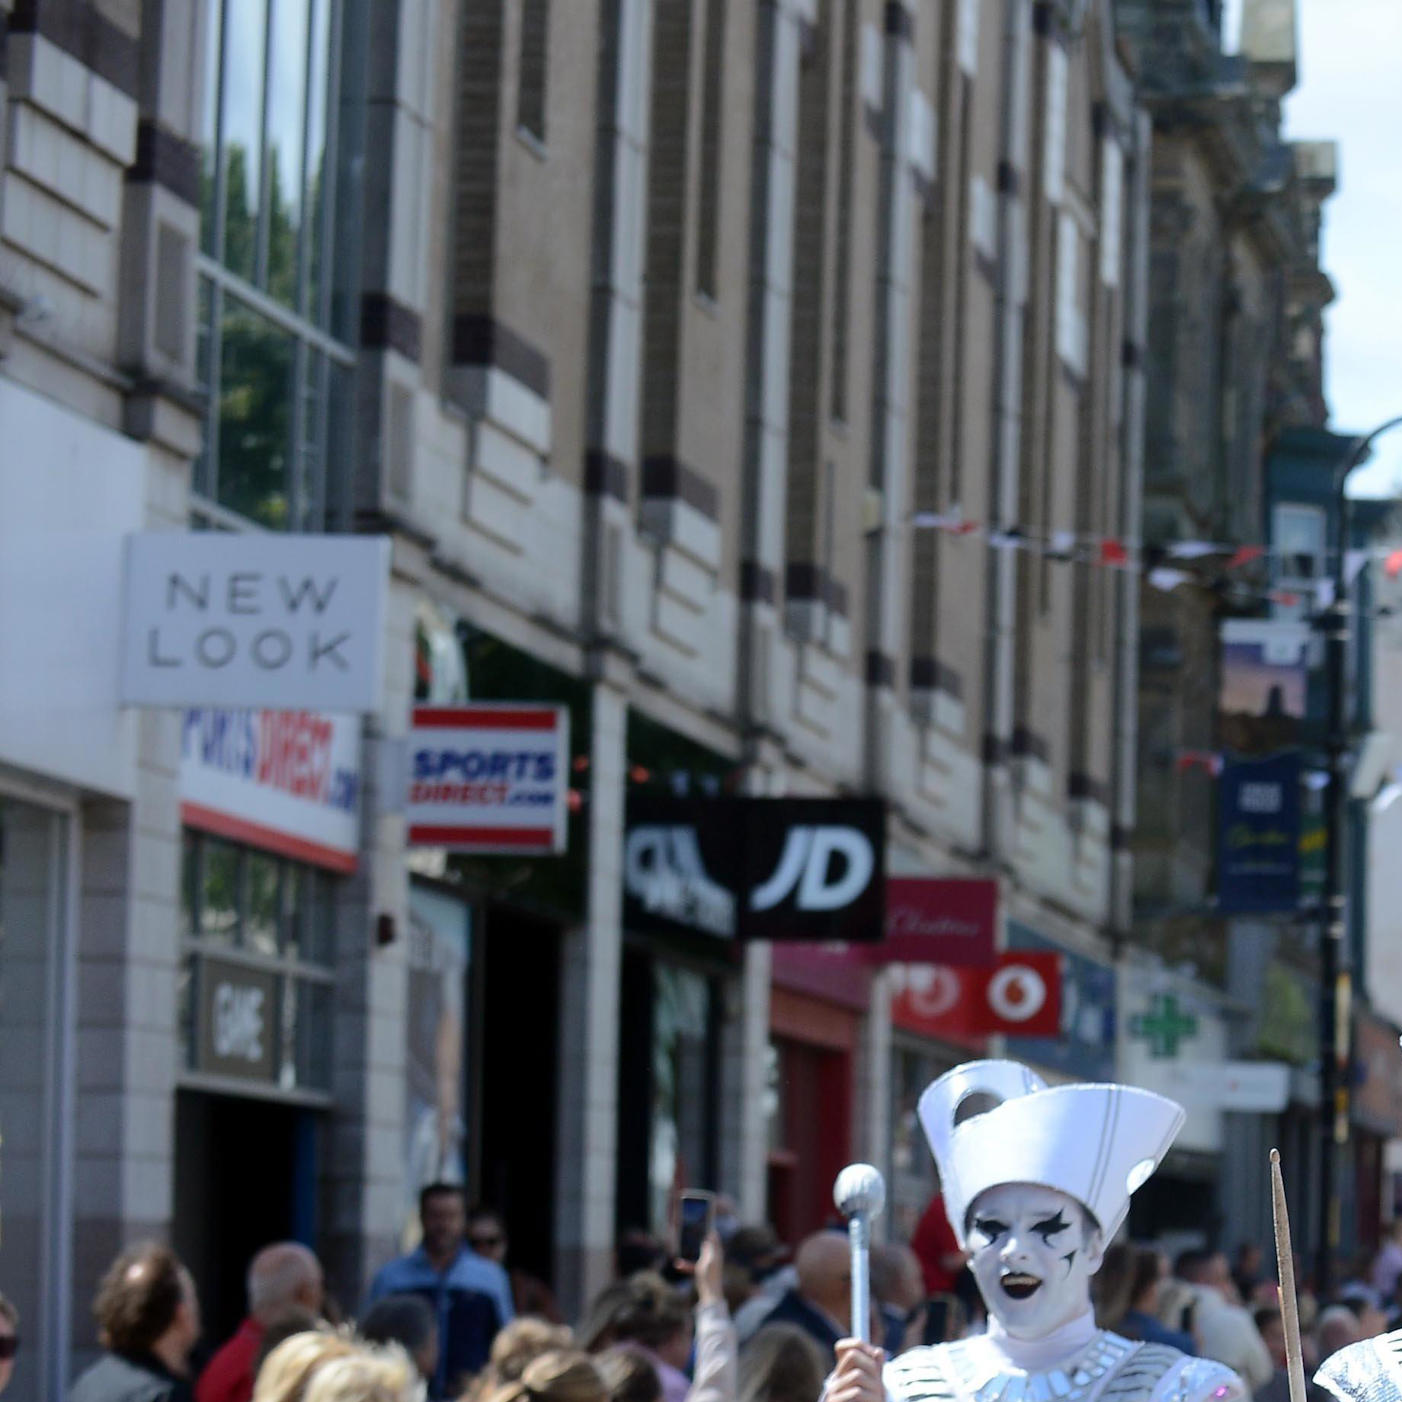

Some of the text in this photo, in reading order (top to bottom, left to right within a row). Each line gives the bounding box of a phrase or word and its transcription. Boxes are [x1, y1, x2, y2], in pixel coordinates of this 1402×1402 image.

[167, 572, 339, 616] NEW
[148, 626, 352, 672] LOOK
[414, 751, 556, 781] SPORTS
[748, 824, 875, 911] JD
